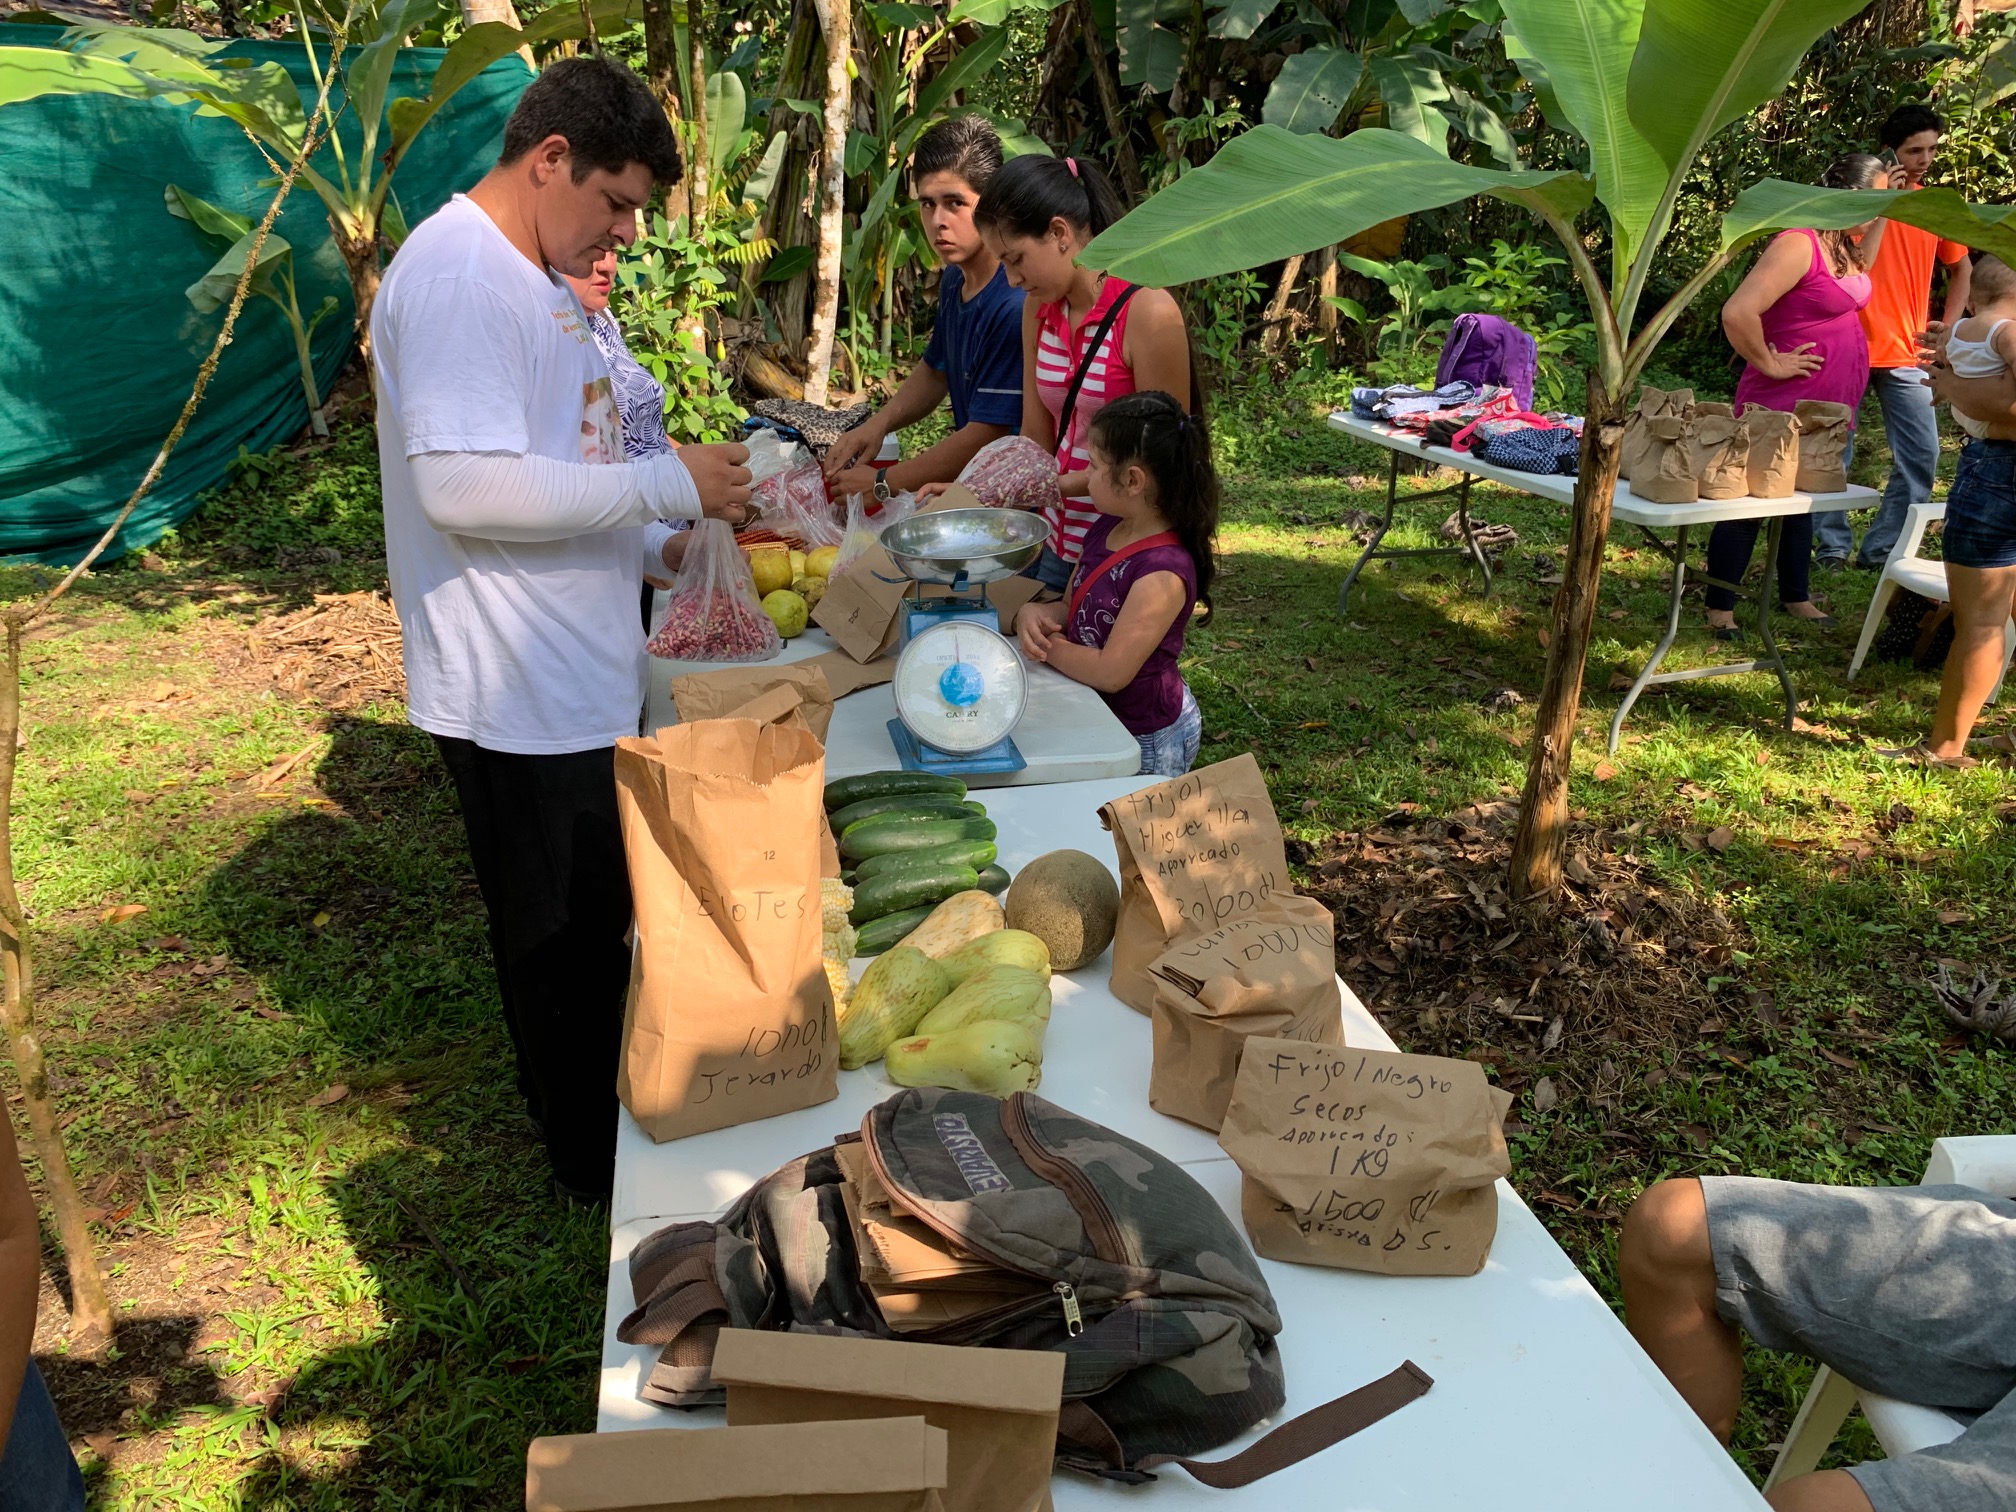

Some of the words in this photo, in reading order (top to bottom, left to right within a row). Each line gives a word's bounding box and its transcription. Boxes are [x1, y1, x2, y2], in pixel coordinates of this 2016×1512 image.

[946, 710, 979, 719] CARY
[763, 850, 776, 860] 12
[1372, 1066, 1452, 1099] Negro
